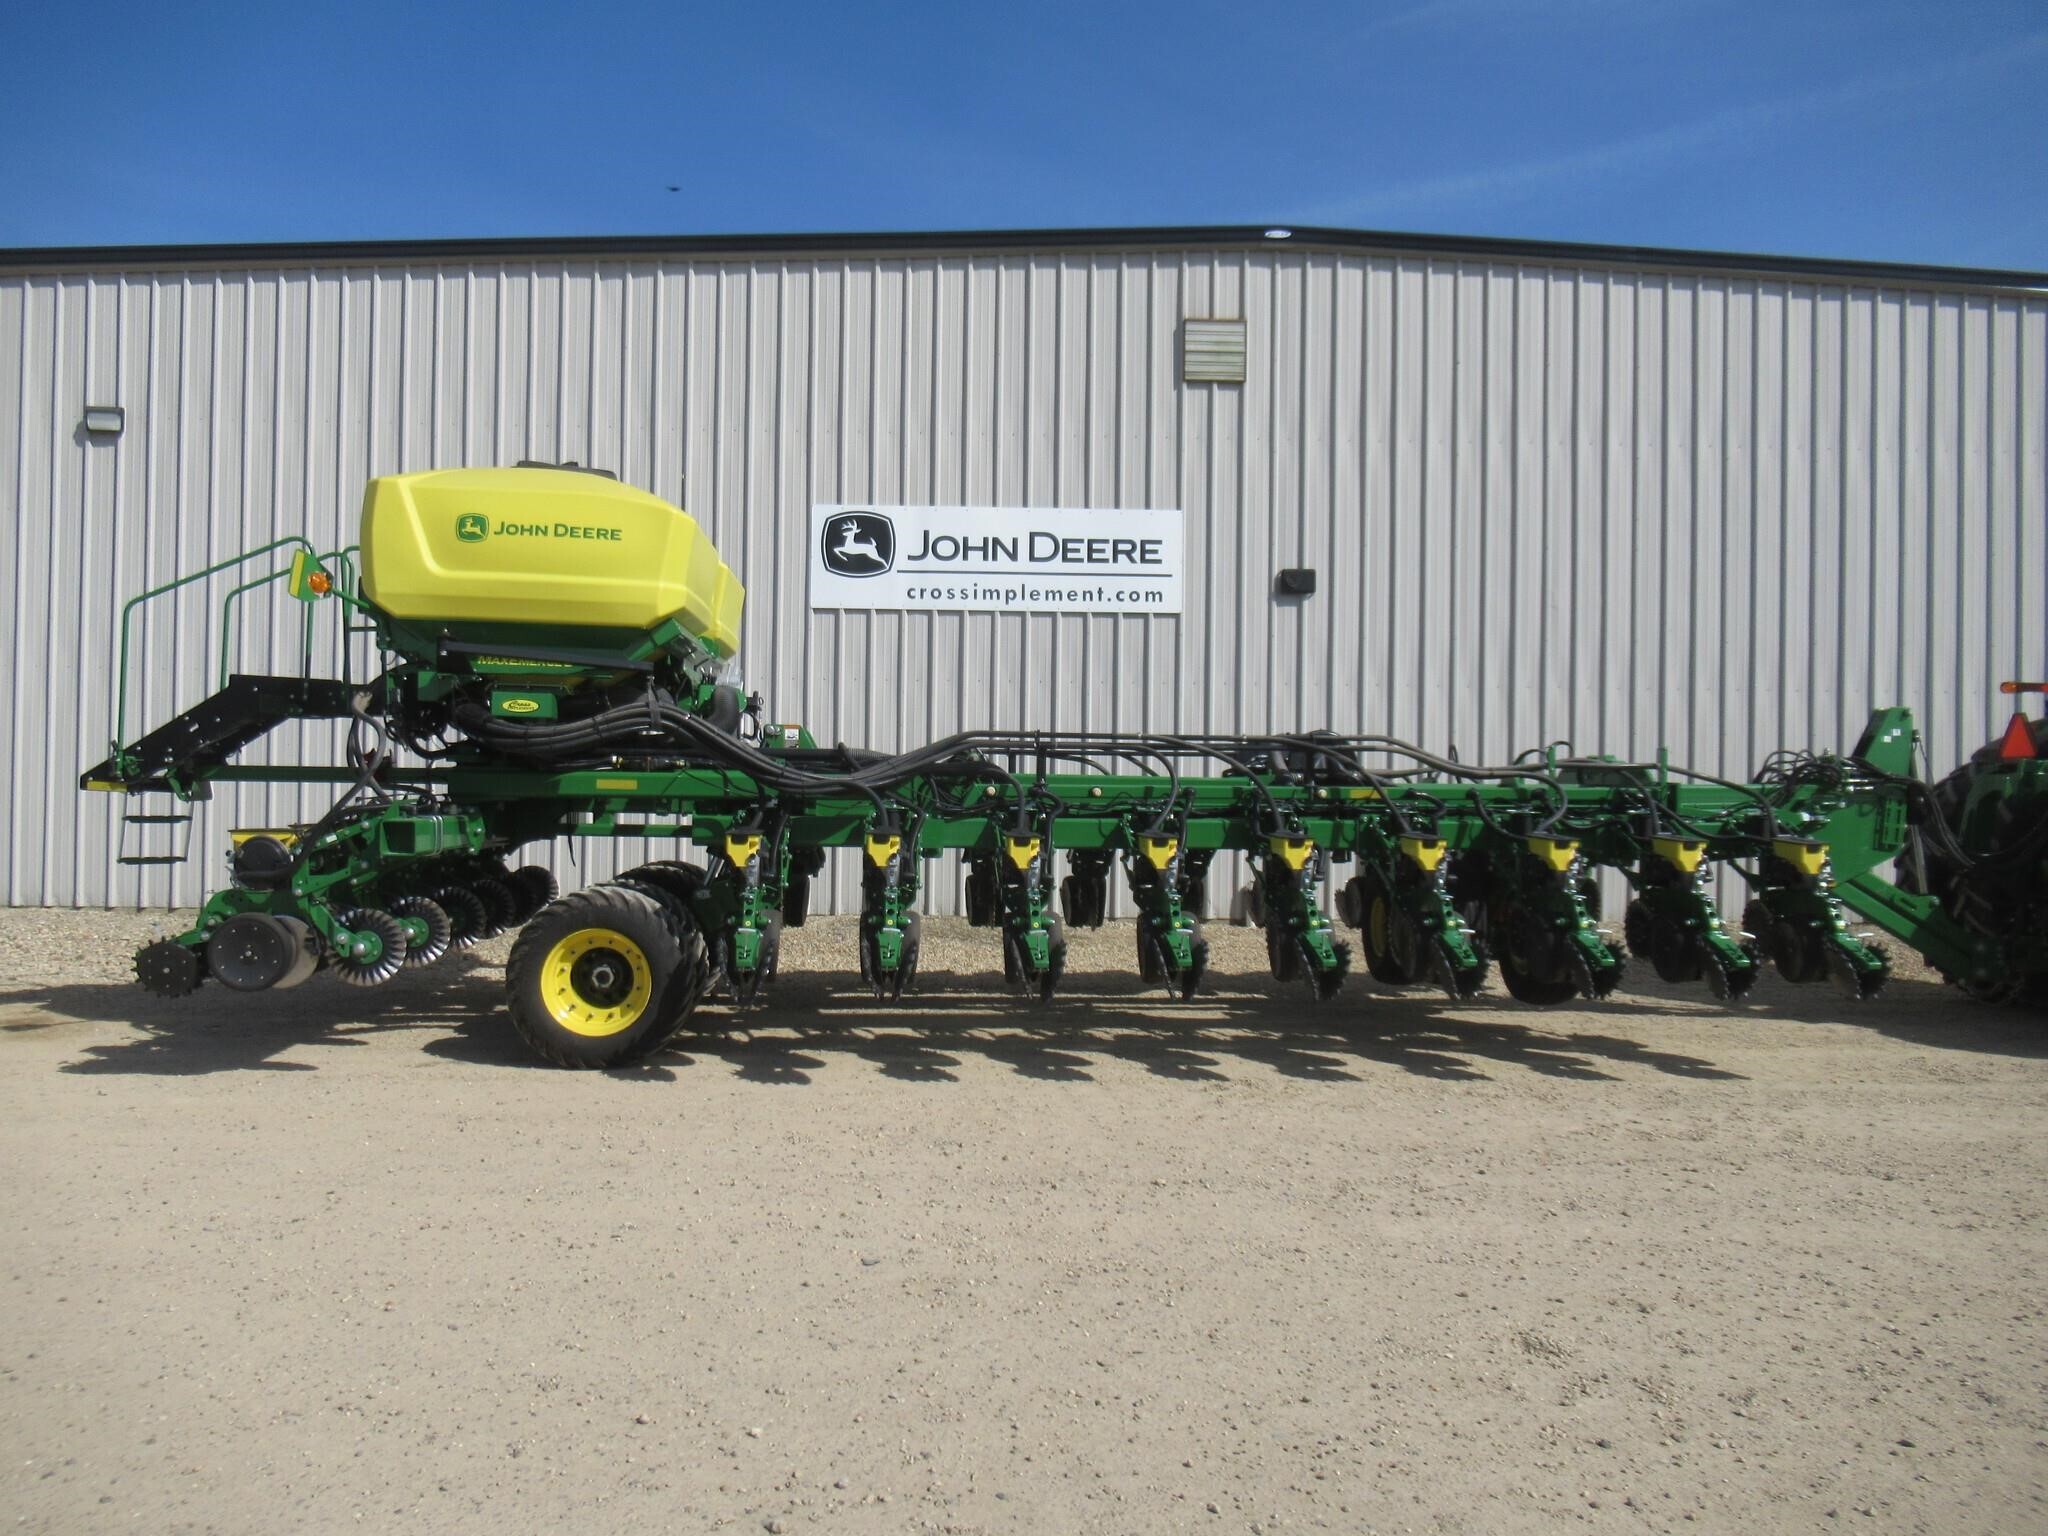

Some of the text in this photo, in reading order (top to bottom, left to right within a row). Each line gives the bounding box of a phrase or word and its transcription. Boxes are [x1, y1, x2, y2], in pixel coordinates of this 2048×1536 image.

[494, 521, 622, 541] JOHN DEERE
[907, 529, 1163, 565] JOHN DEERE
[907, 583, 1163, 604] crossimplement.com
